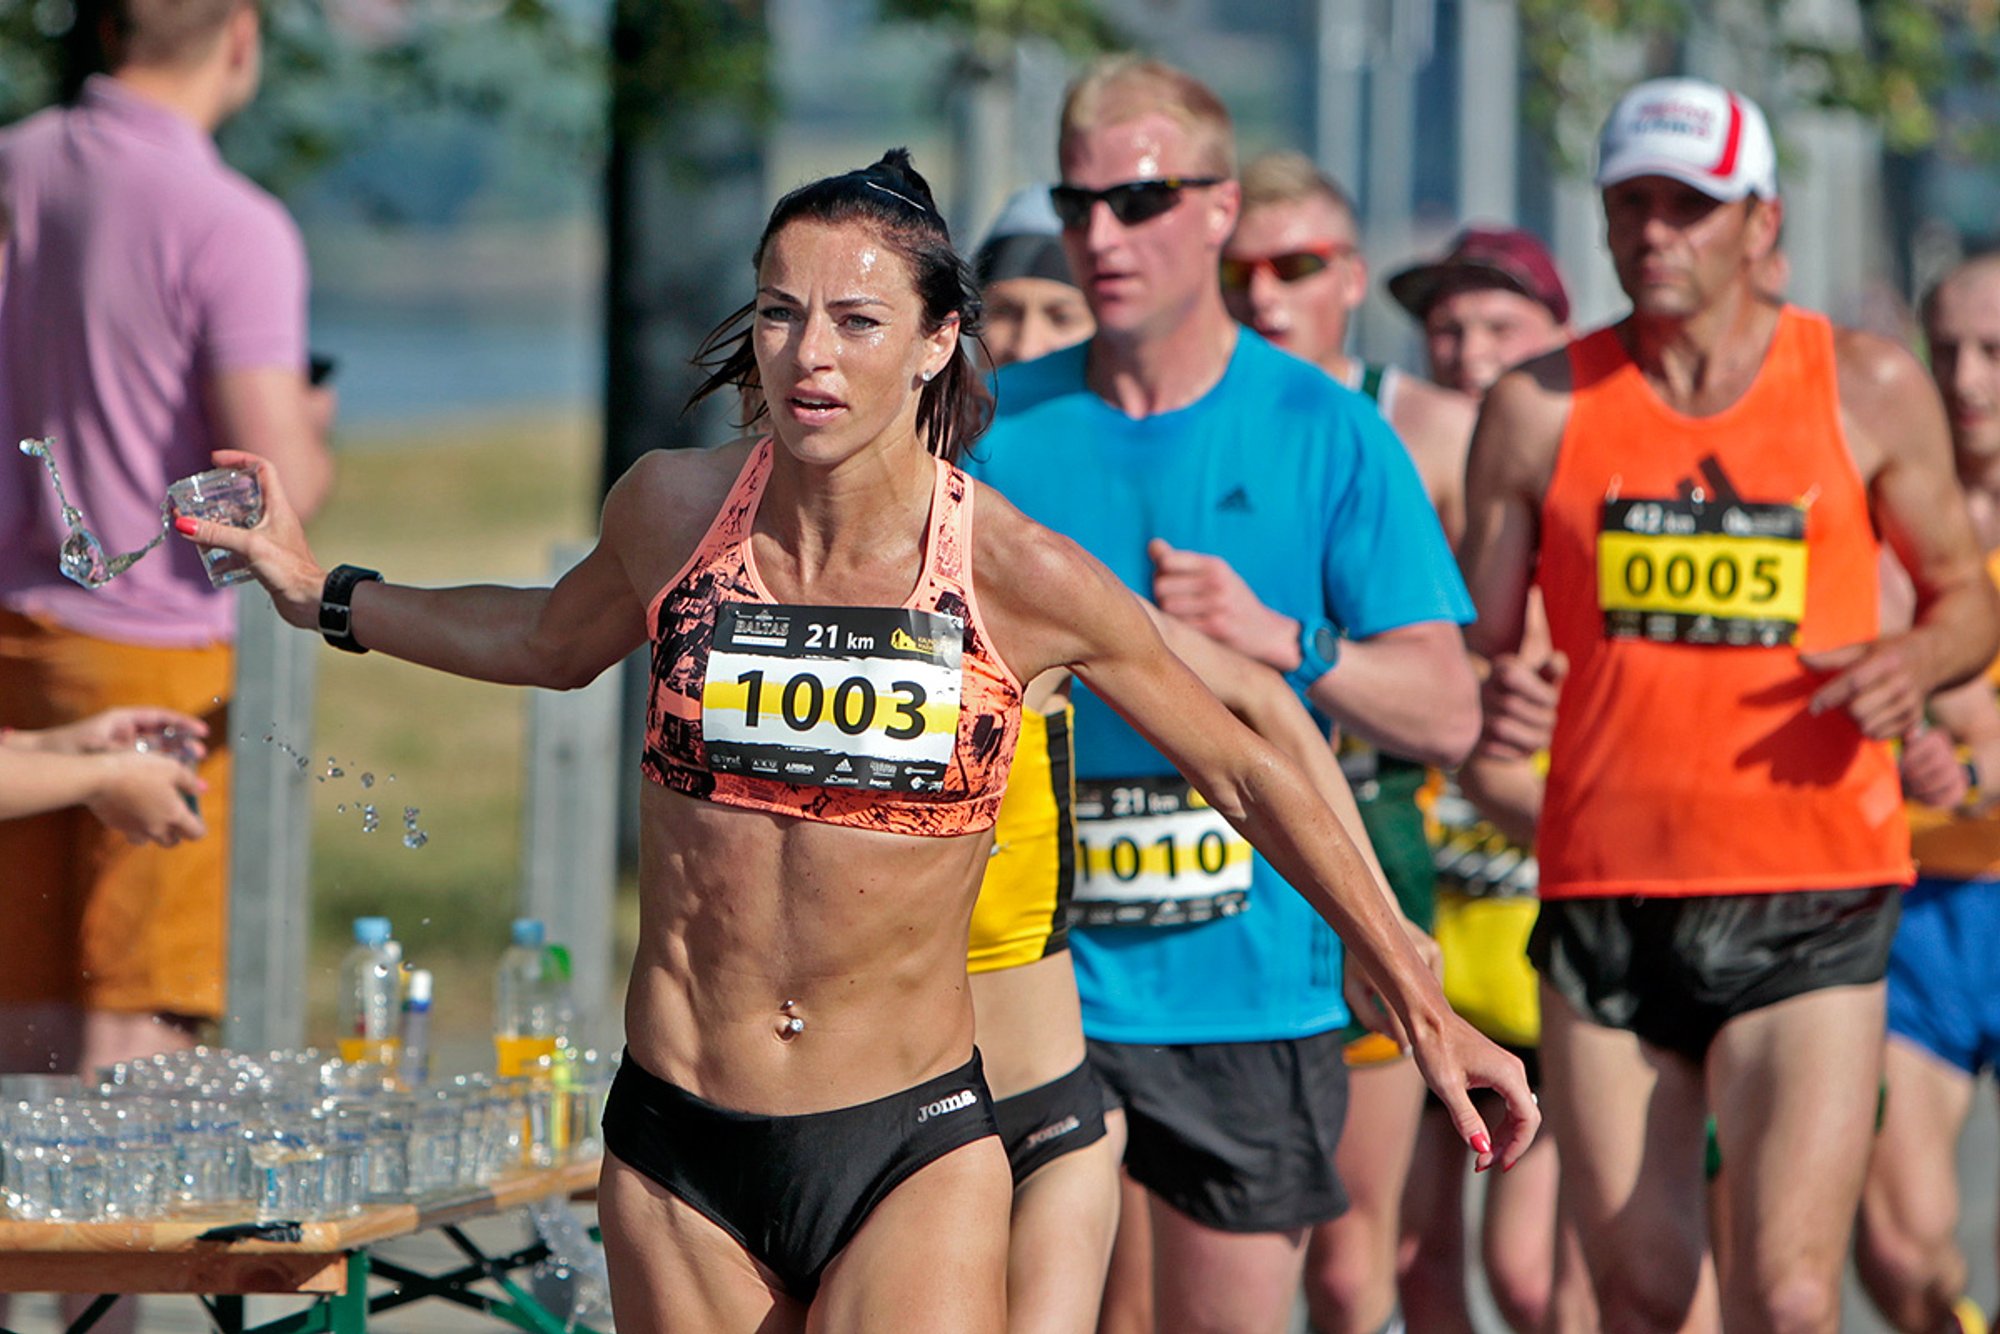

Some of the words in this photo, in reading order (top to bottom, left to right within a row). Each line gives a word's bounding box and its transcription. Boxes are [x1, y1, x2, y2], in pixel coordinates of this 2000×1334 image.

[1624, 502, 1664, 534] 42
[1624, 552, 1782, 604] 0005
[734, 619, 790, 637] BALTAS
[804, 623, 839, 649] 21
[846, 632, 875, 650] km
[737, 669, 928, 740] 1003
[1111, 786, 1146, 816] 21
[1079, 830, 1226, 883] 1010
